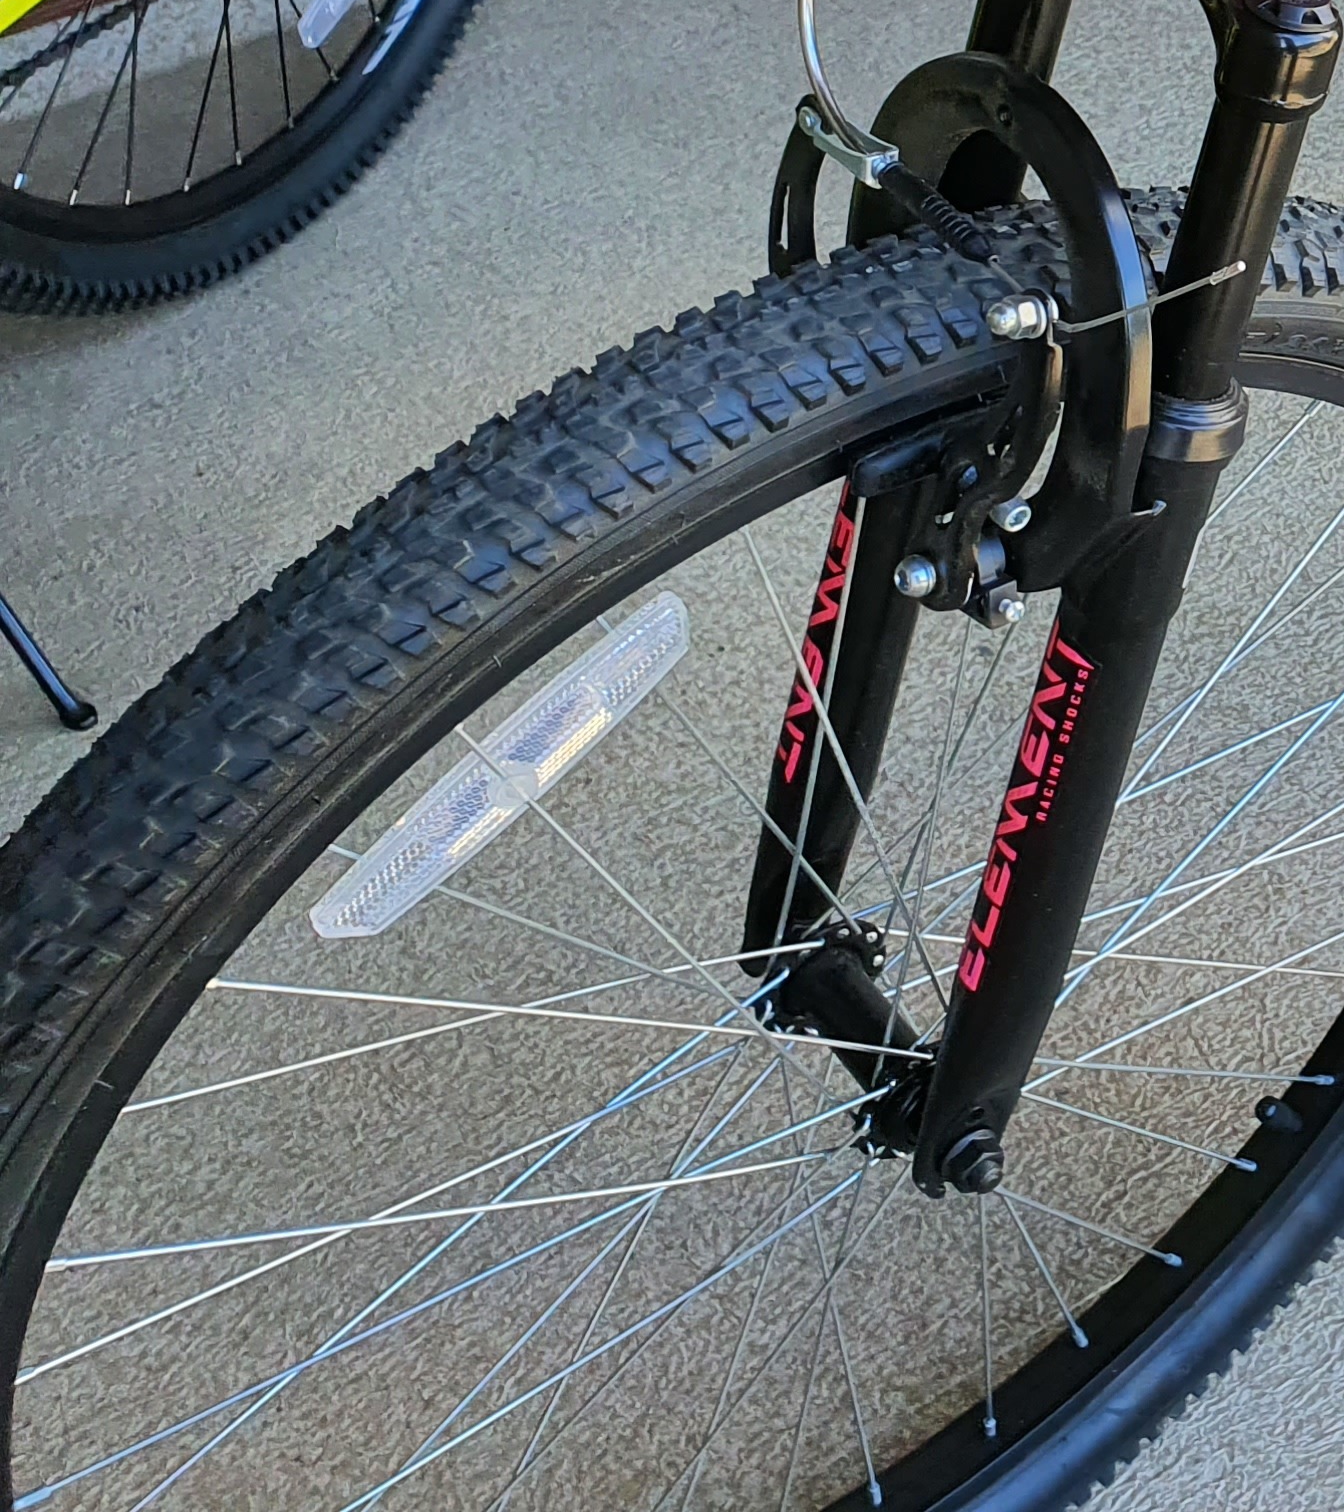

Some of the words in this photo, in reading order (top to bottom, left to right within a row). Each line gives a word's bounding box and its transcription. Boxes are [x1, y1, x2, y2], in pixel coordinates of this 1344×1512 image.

[959, 617, 1095, 991] ELEMENT
[1035, 754, 1065, 822] RACING
[1059, 668, 1090, 744] SHOCKS
